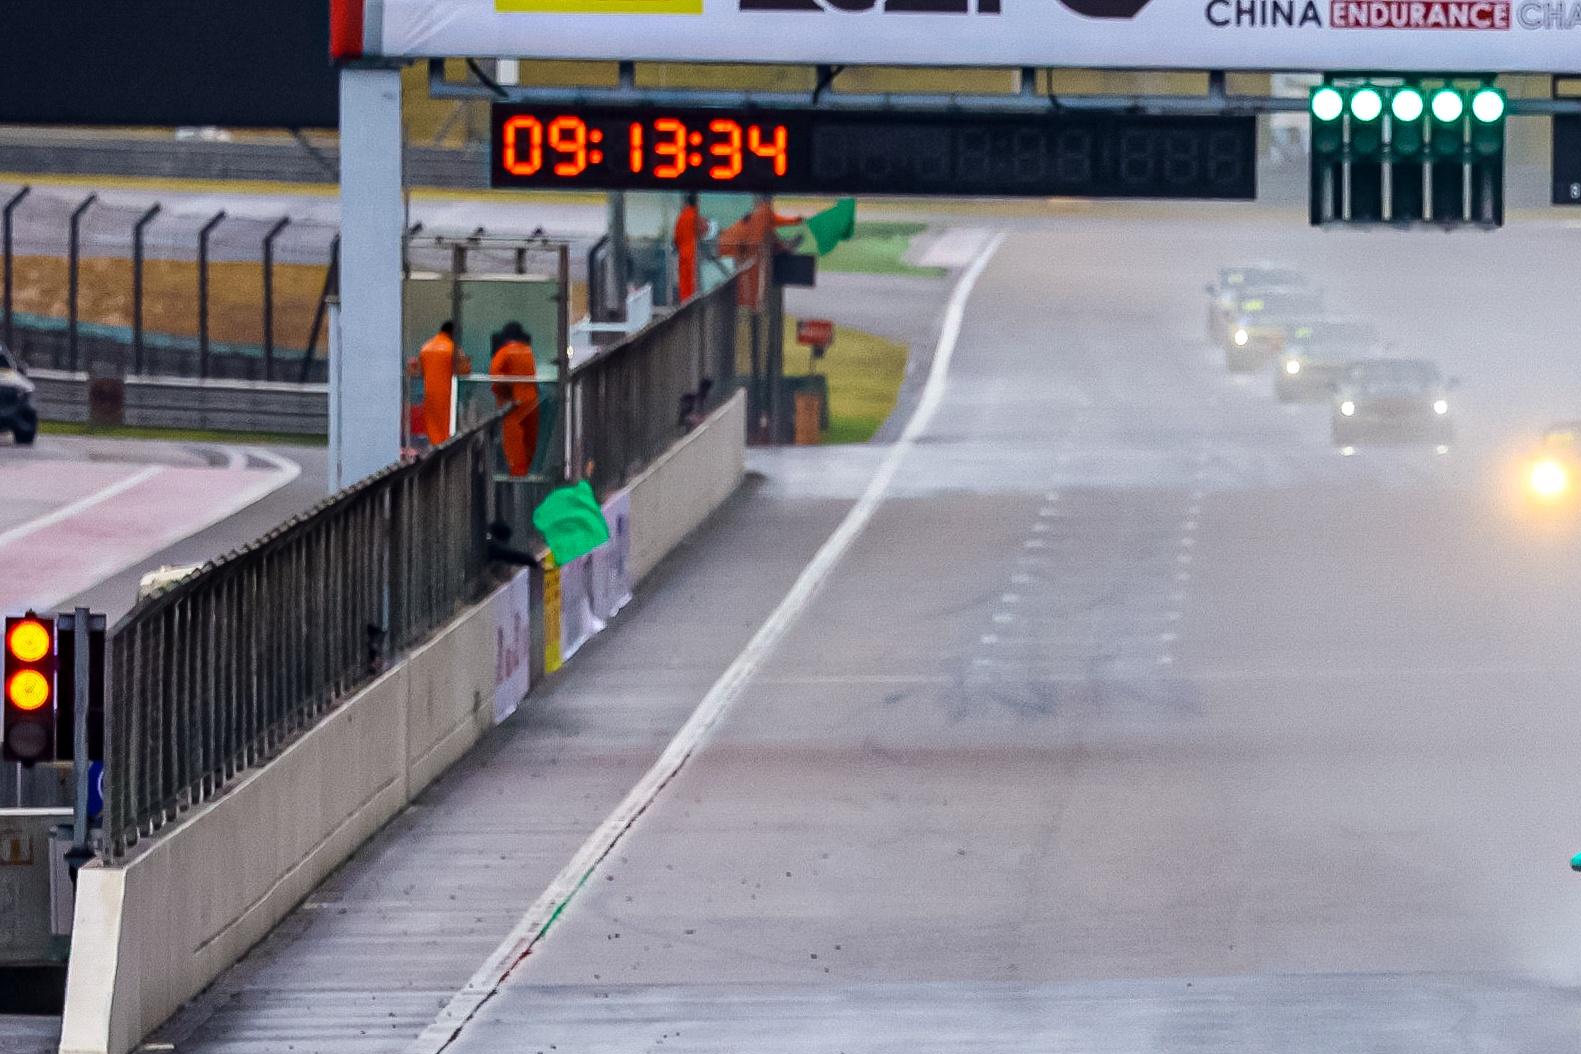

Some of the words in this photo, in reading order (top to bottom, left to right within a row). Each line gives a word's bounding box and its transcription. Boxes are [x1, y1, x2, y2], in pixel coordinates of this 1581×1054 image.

[1205, 0, 1322, 28] CHINA
[1332, 1, 1509, 28] ENDURANCE
[503, 115, 788, 181] 09:13:34
